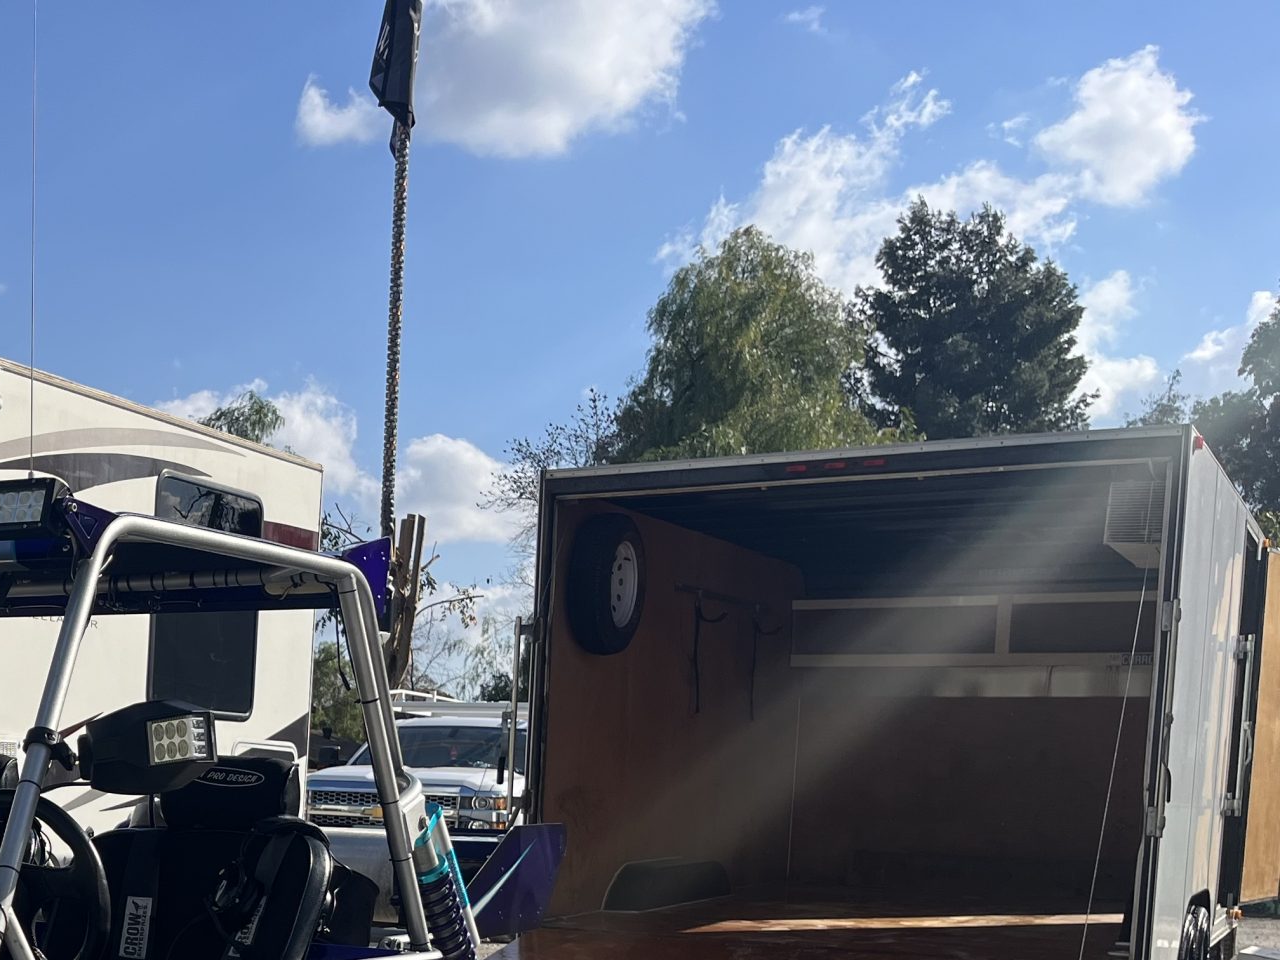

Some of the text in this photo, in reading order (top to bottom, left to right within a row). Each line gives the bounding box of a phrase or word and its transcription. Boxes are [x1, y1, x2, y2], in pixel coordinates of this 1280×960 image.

[206, 770, 259, 784] PRO DESIGN
[123, 912, 142, 957] CROW
